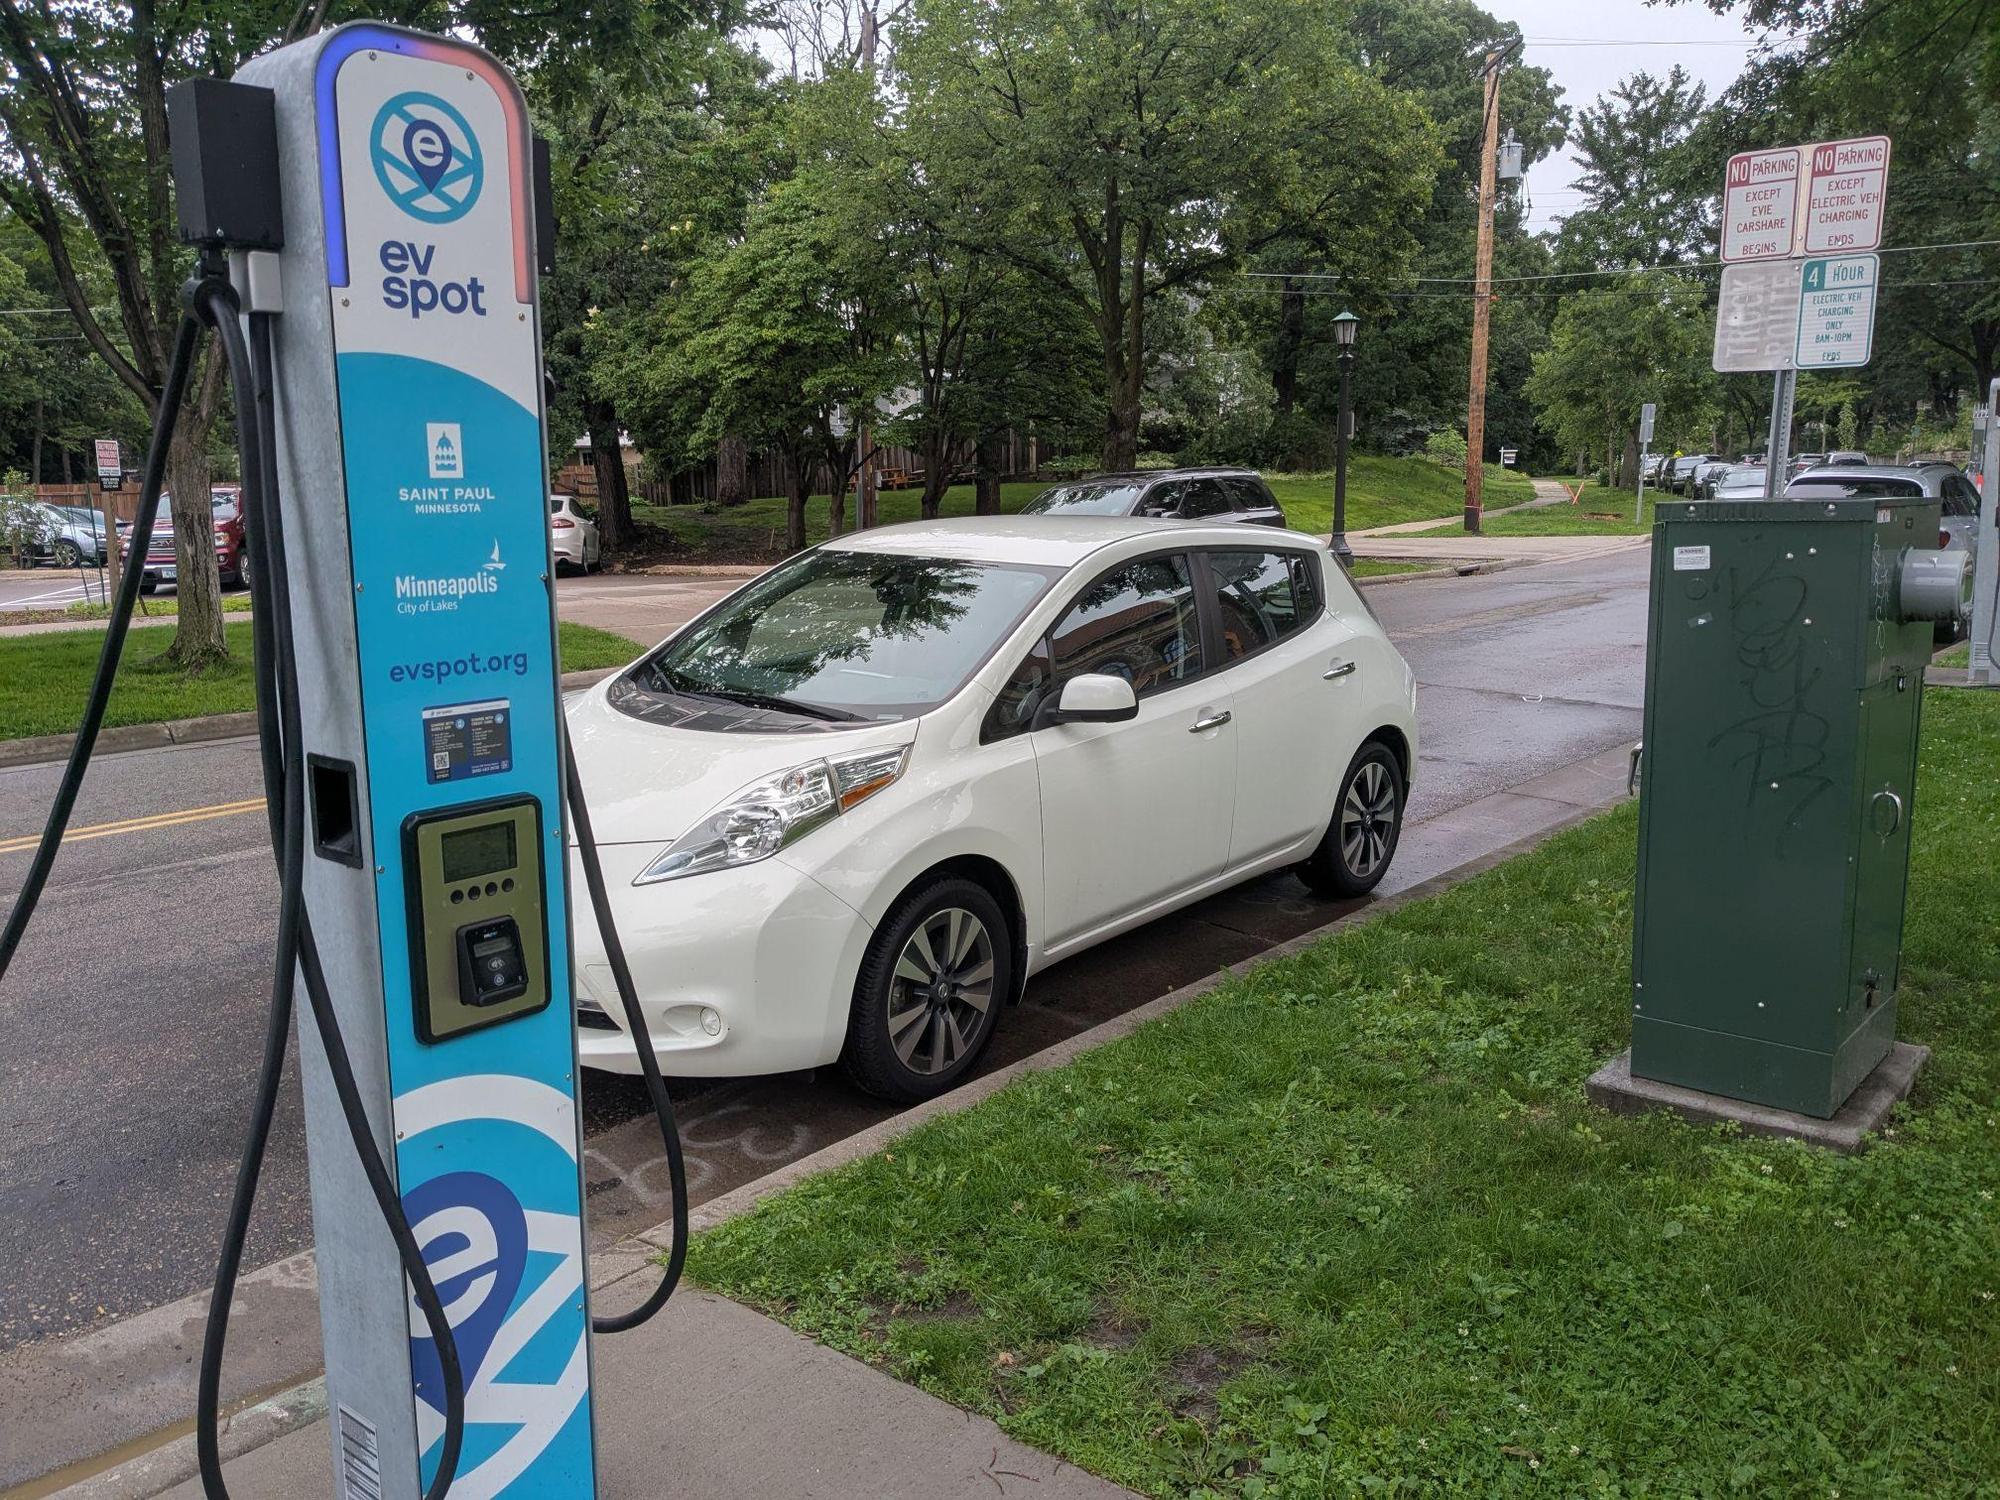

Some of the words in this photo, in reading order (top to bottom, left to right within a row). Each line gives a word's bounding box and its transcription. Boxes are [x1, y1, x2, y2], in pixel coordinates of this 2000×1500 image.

[1815, 149, 1834, 172] NO
[1837, 148, 1883, 166] PARKING
[1731, 161, 1749, 183] NO
[1752, 158, 1795, 177] PARKING
[1828, 177, 1866, 192] EXCEPT
[1745, 187, 1782, 203] EXCEPT
[1811, 194, 1856, 209] ELECTRIC
[1860, 192, 1879, 204] VEH
[1752, 204, 1773, 217] EVIE
[1818, 208, 1869, 224] CHARGING
[1736, 217, 1787, 234] CARSHARE
[1742, 241, 1777, 256] BEGINS
[1827, 234, 1855, 247] ENDS
[379, 240, 436, 276] ev
[1807, 266, 1819, 287] 4
[1832, 265, 1865, 282] HOUR
[382, 276, 487, 319] spot
[1812, 293, 1844, 305] ELECTRIC
[1848, 291, 1862, 302] VEH
[1817, 305, 1855, 318] CHARGING
[1825, 320, 1844, 331] ONLY
[1822, 351, 1841, 362] ENDS
[399, 487, 449, 501] SAINT
[454, 487, 496, 500] PAUL
[415, 503, 482, 514] MINNESOTA
[395, 572, 498, 600] Minneapolis
[397, 602, 417, 616] City
[419, 600, 430, 612] of
[431, 599, 458, 611] Lakes
[390, 652, 528, 684] evspot.org
